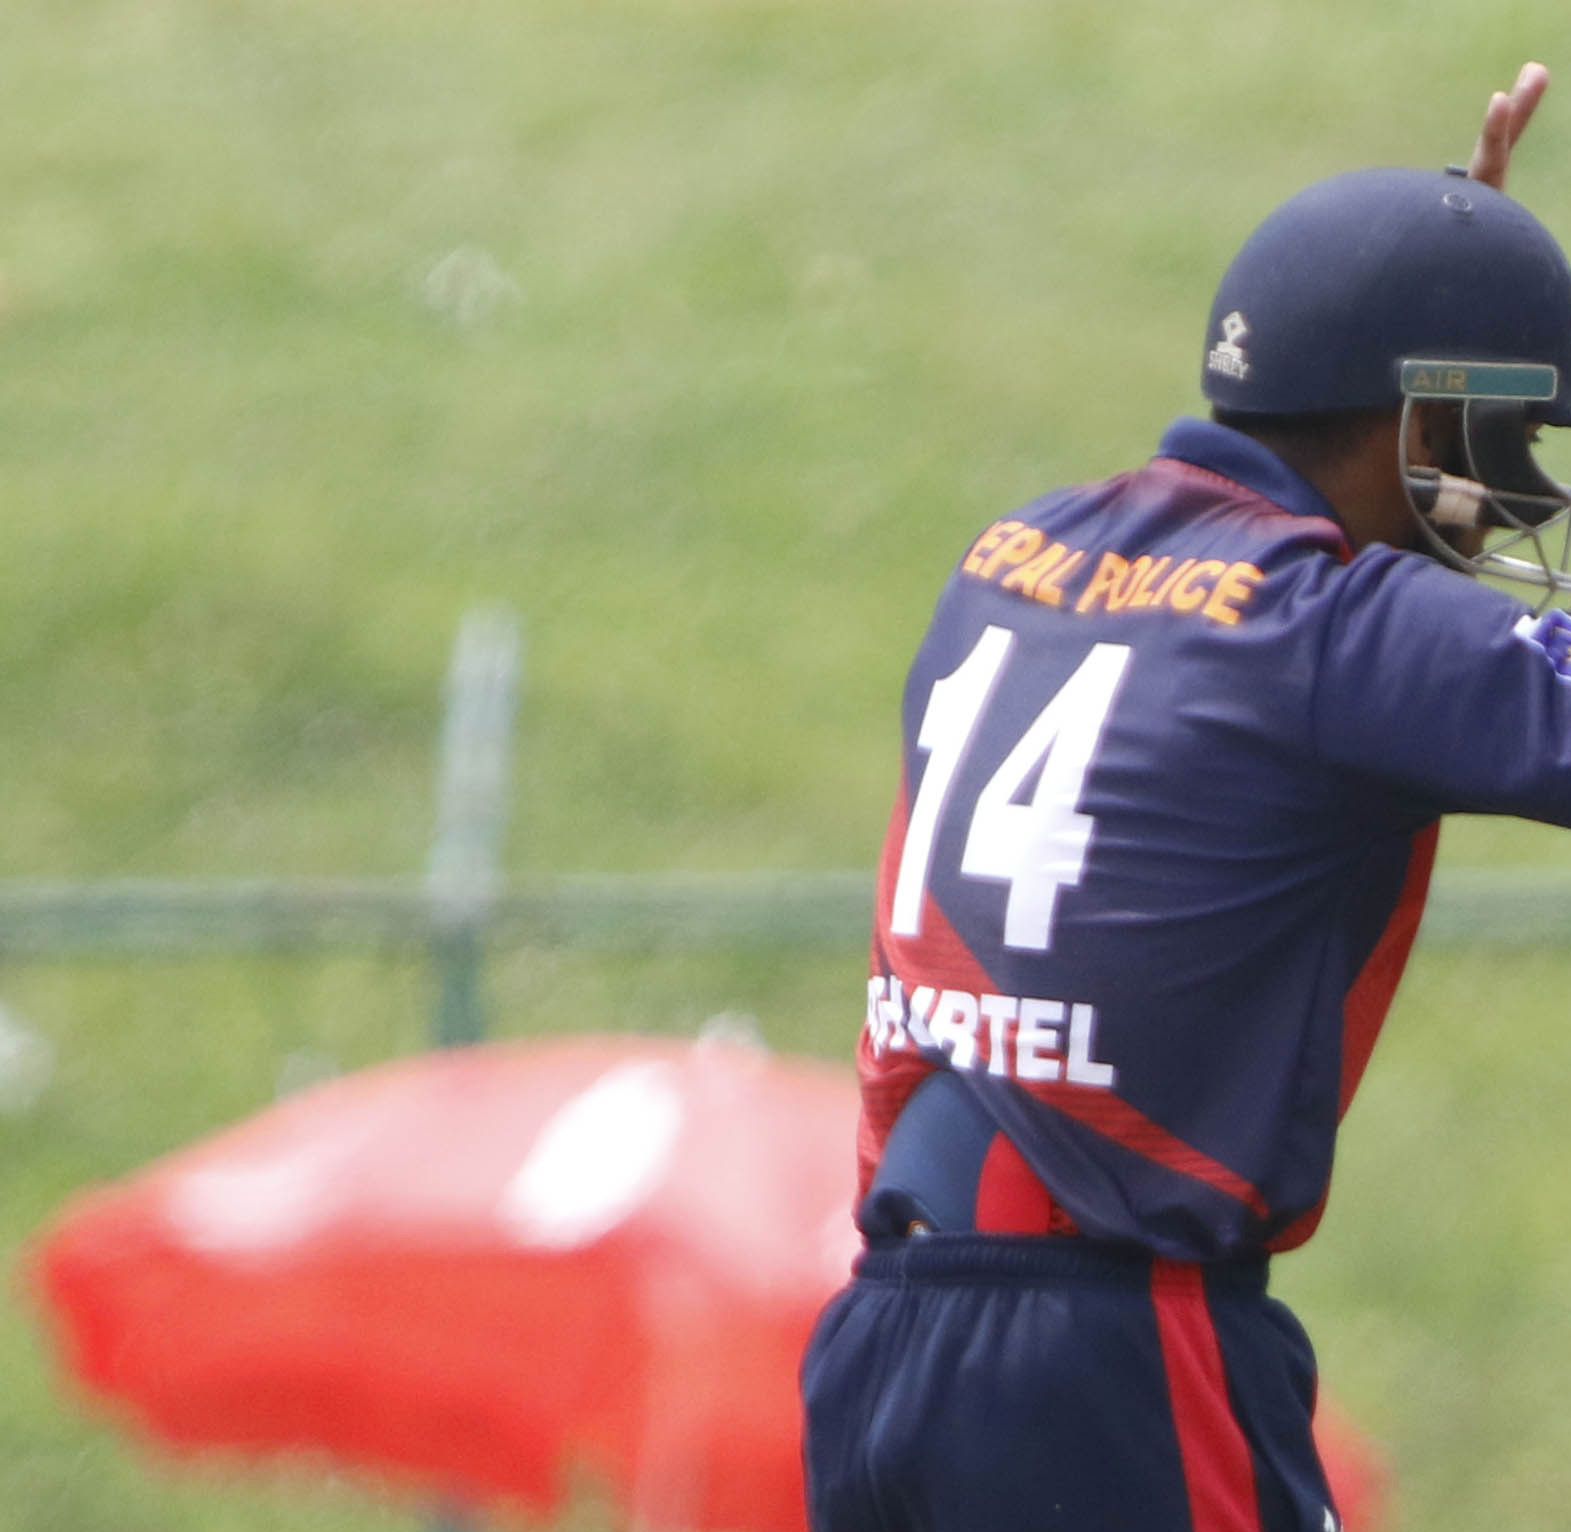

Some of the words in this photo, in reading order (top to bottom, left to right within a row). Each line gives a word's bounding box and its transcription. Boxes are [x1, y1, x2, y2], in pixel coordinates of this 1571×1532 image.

[962, 519, 1085, 606] EPAL
[1075, 551, 1266, 625] POLICE
[891, 624, 1132, 951] 14
